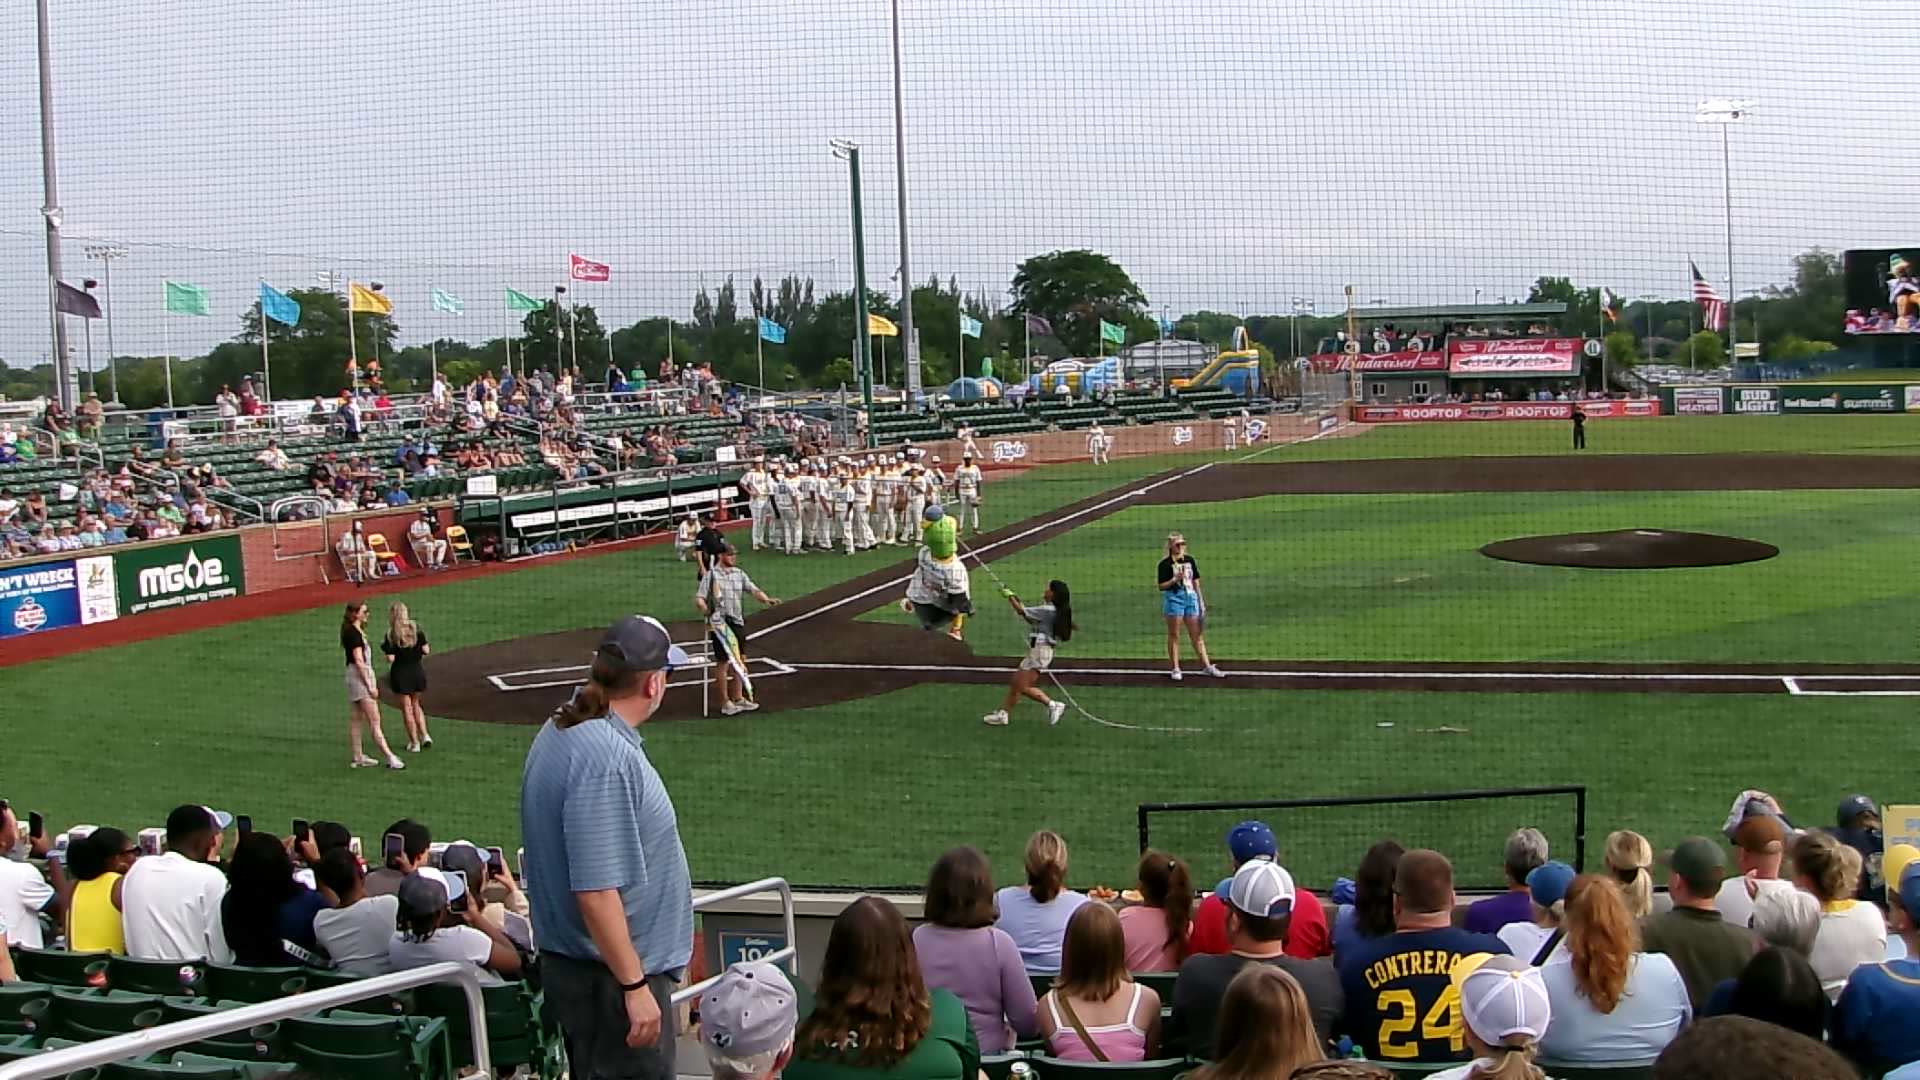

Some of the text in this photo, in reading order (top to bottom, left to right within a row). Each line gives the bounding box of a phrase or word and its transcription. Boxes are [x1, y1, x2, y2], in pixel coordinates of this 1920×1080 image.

[1742, 389, 1771, 400] BUD
[1735, 400, 1777, 411] LIGHT
[1403, 408, 1462, 418] ROOFTOP
[1506, 406, 1568, 417] ROOFTOP
[24, 567, 75, 587] WRECK
[1365, 950, 1461, 989] CONTRERA
[1377, 984, 1464, 1058] 24
